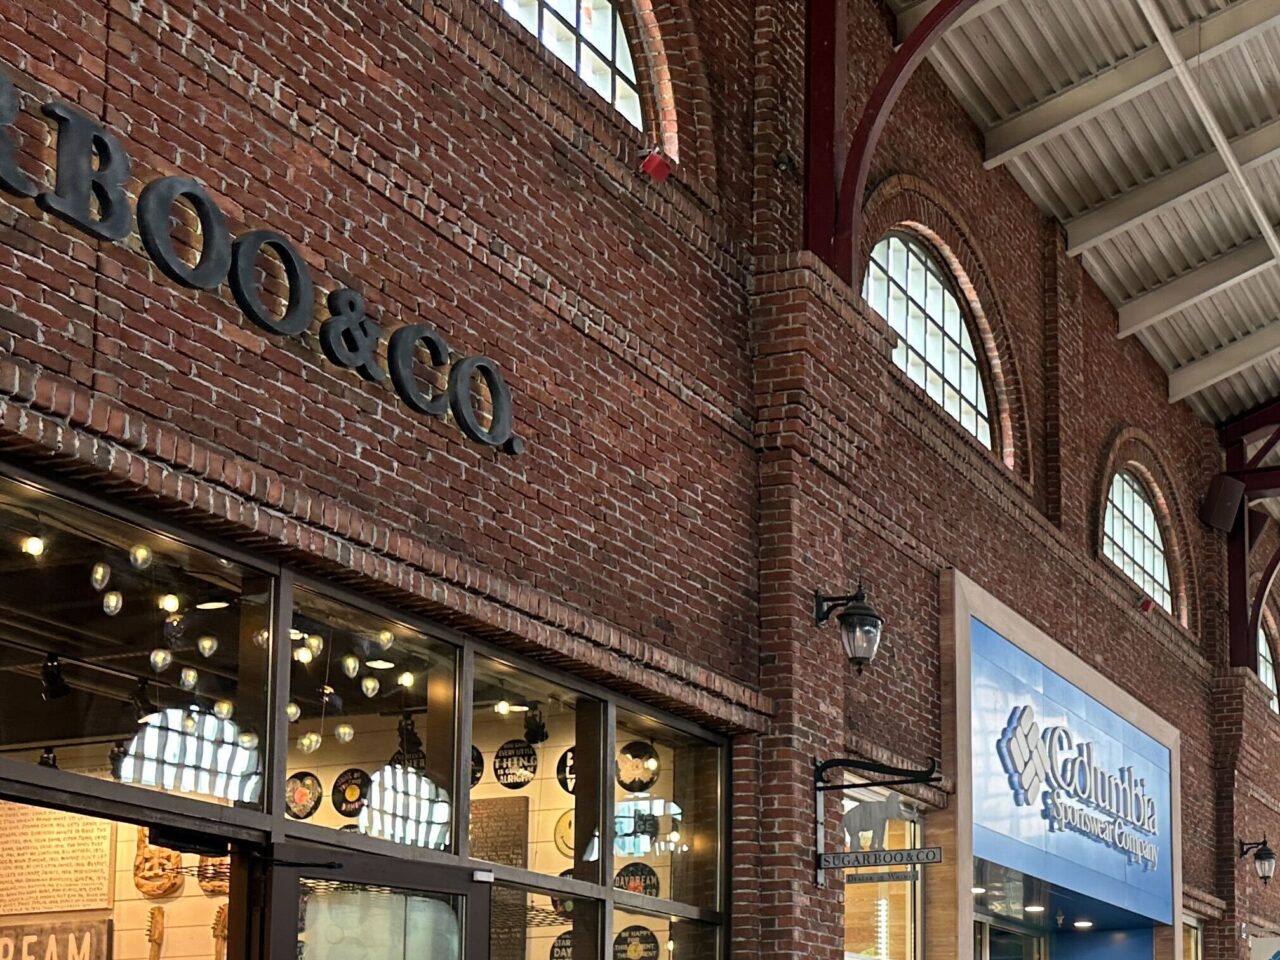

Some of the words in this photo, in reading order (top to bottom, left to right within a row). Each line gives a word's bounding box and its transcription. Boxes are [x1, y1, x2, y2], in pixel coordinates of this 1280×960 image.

[1042, 726, 1158, 836] Columbia
[1050, 790, 1114, 843] Sportswear
[1114, 818, 1159, 871] Company
